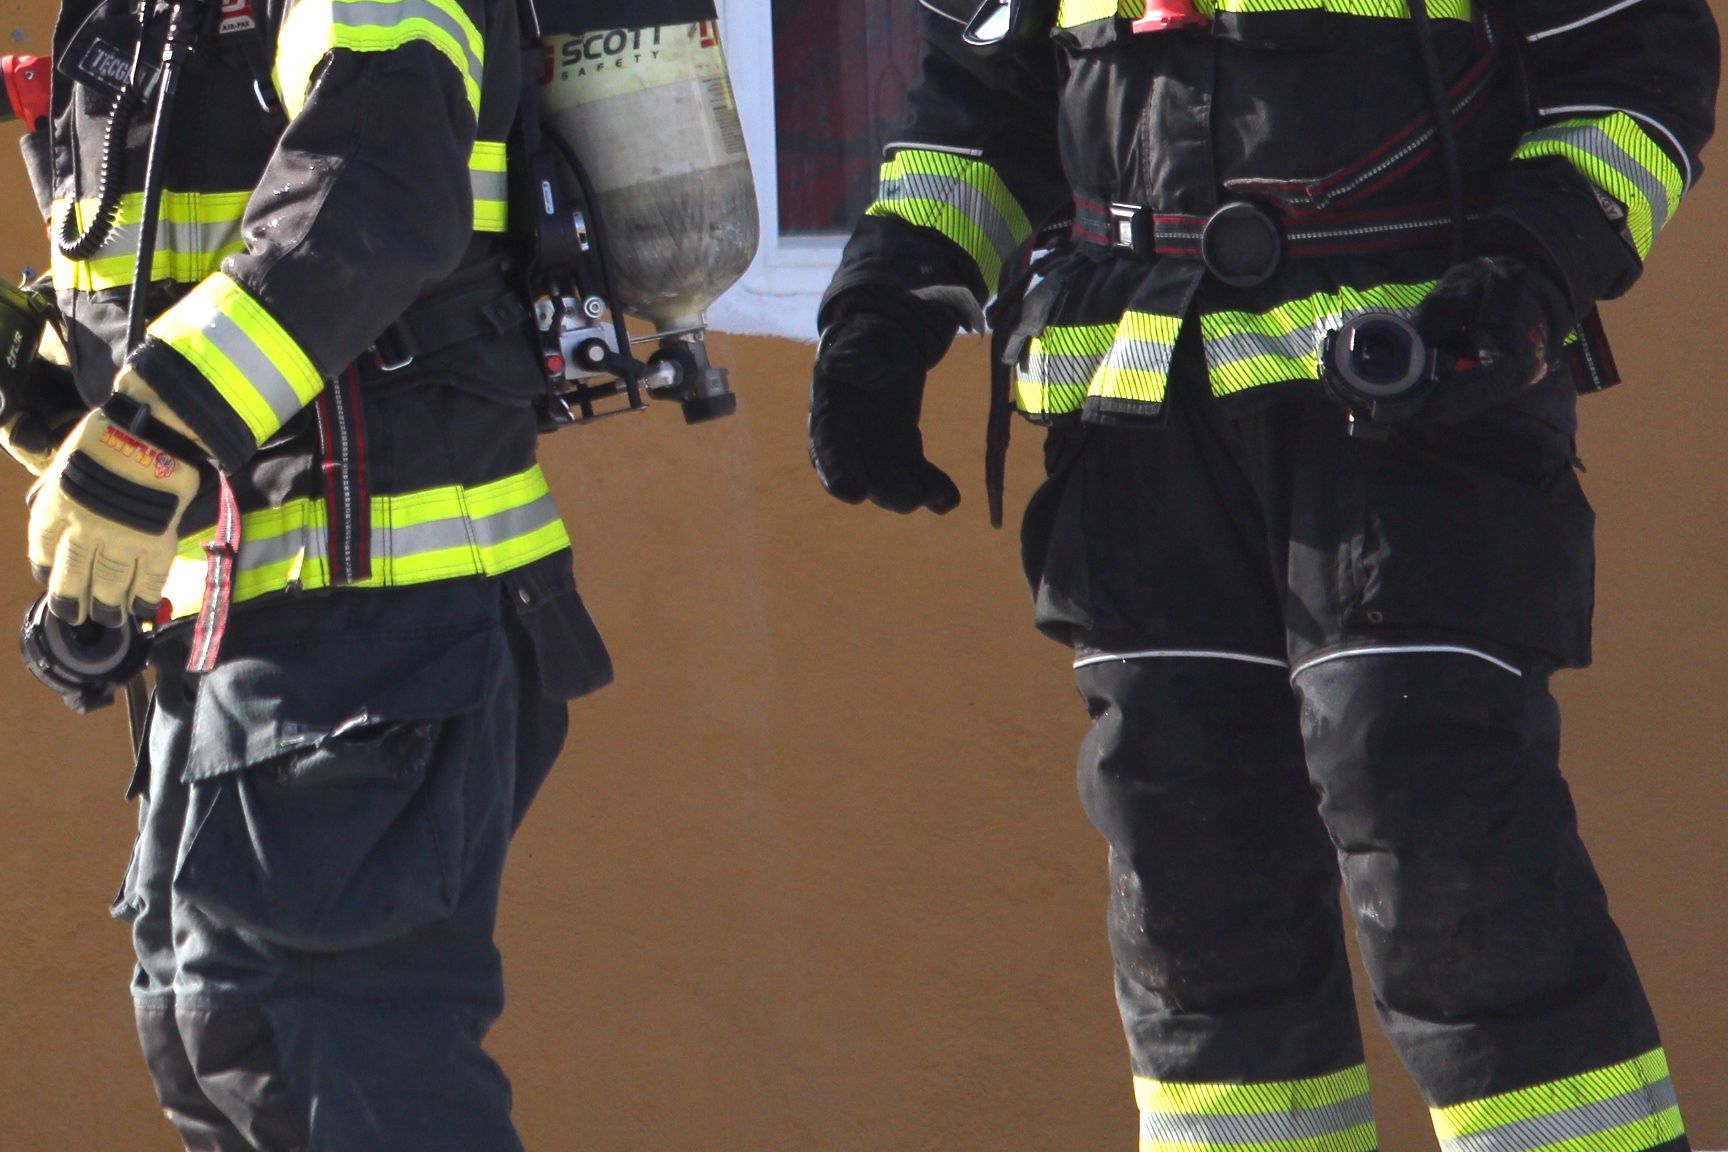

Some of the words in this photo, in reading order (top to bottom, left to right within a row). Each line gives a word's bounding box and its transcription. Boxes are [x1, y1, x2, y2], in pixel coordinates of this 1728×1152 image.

[561, 50, 659, 80] SAFETY
[562, 27, 660, 66] SCOTT
[92, 49, 146, 87] TECGN
